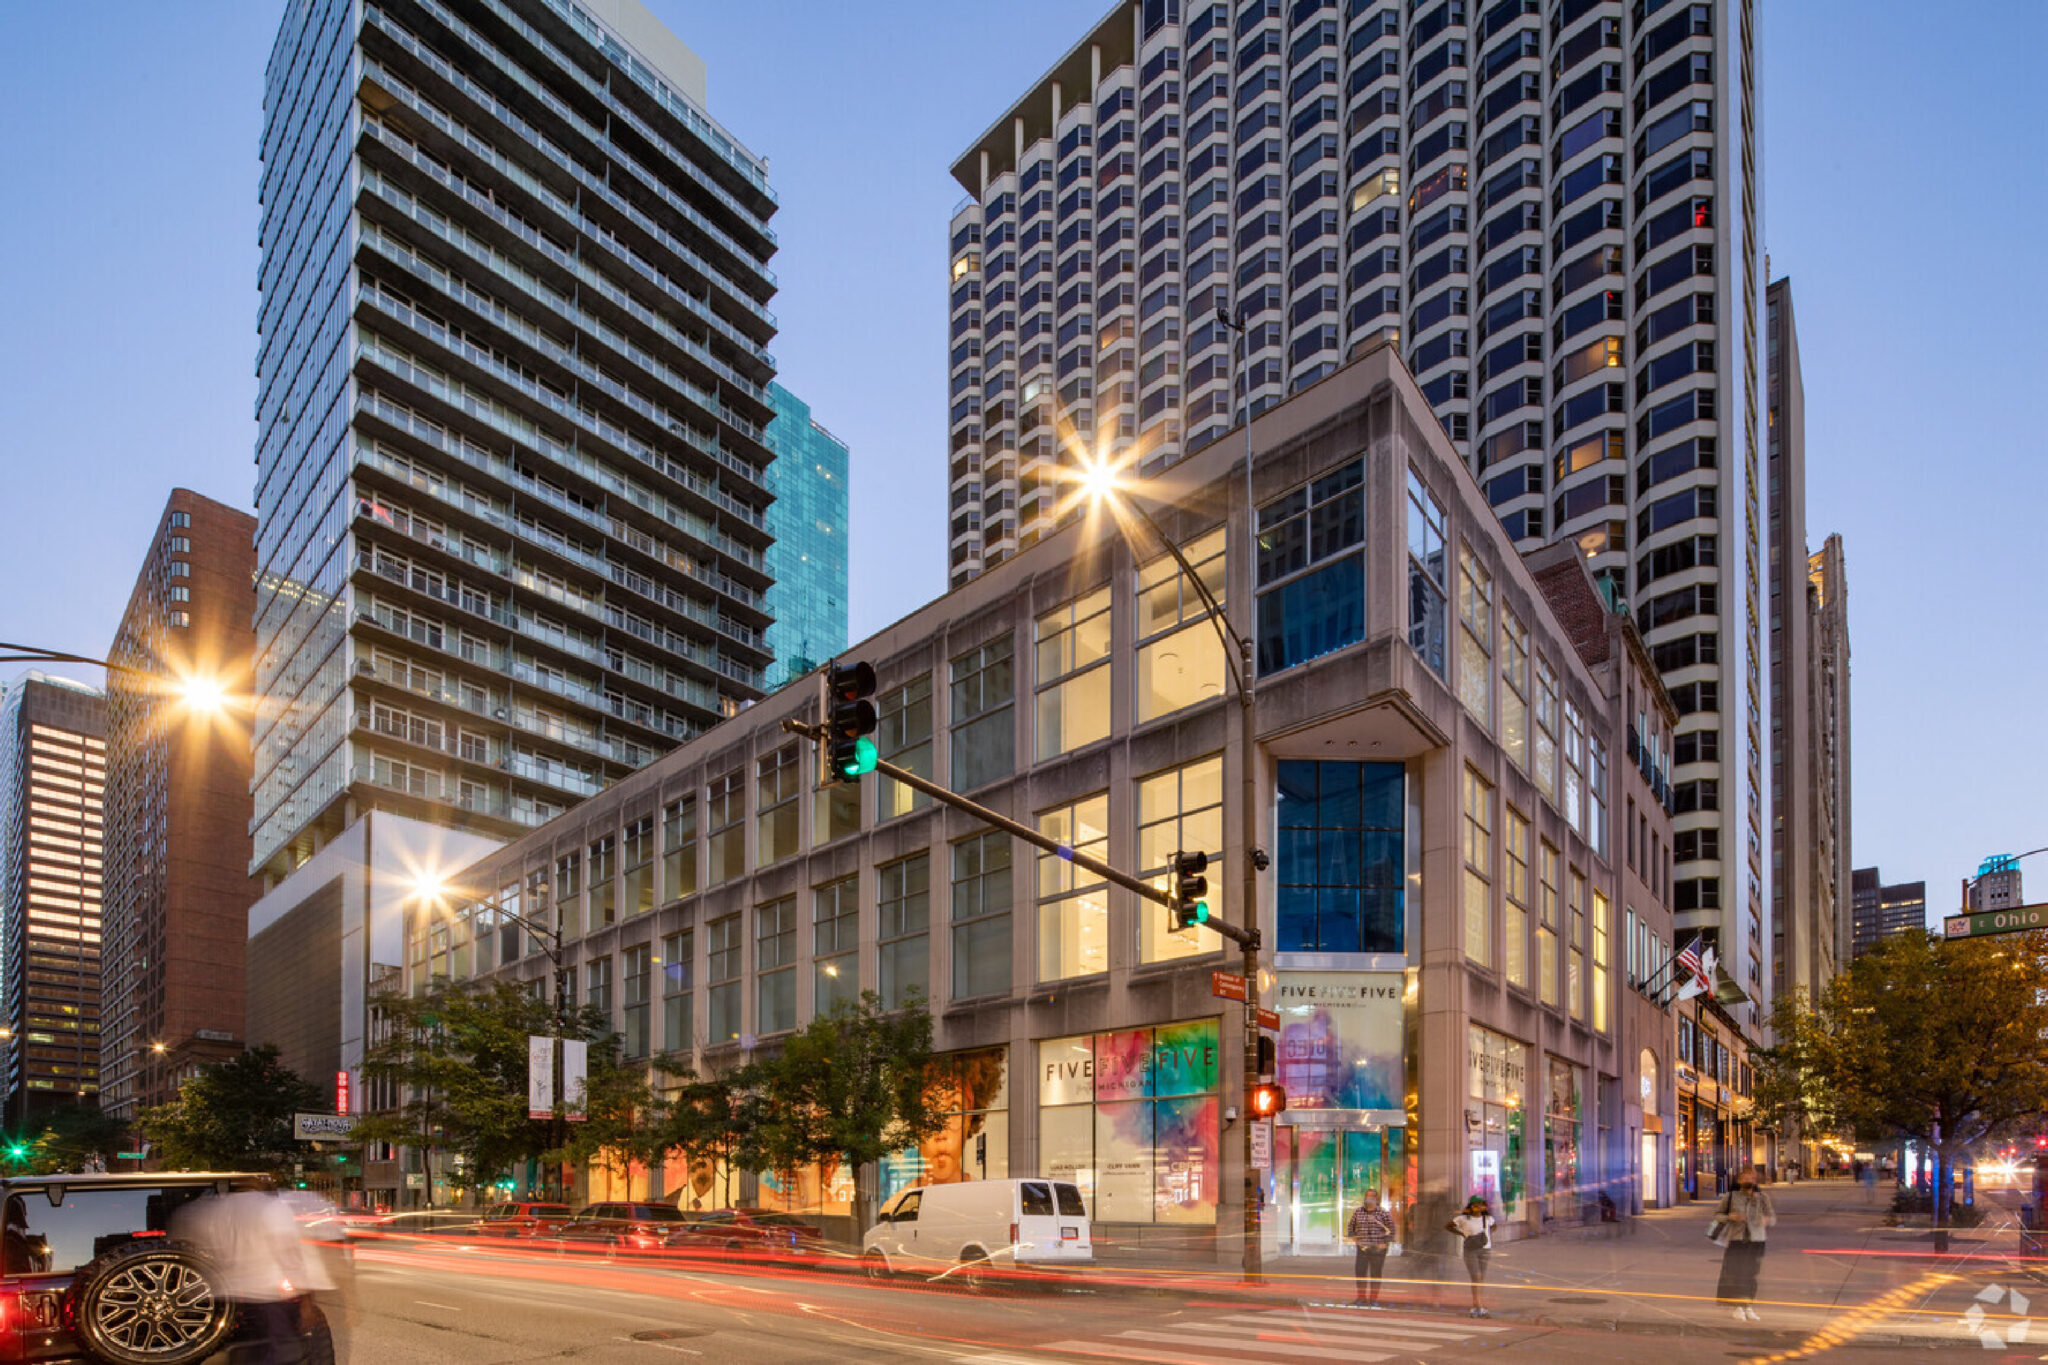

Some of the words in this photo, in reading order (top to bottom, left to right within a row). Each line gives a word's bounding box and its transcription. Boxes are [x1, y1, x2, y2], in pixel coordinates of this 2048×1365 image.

[1995, 912, 2040, 928] Ohio
[1281, 986, 1316, 997] FIVE
[1361, 987, 1396, 999] FIVE
[1046, 1060, 1093, 1081] FIVE
[1099, 1051, 1150, 1077] FIVE
[1158, 1047, 1213, 1071] FIVE
[1507, 1062, 1524, 1083] FIVE
[1098, 1079, 1153, 1091] MICHIGAN
